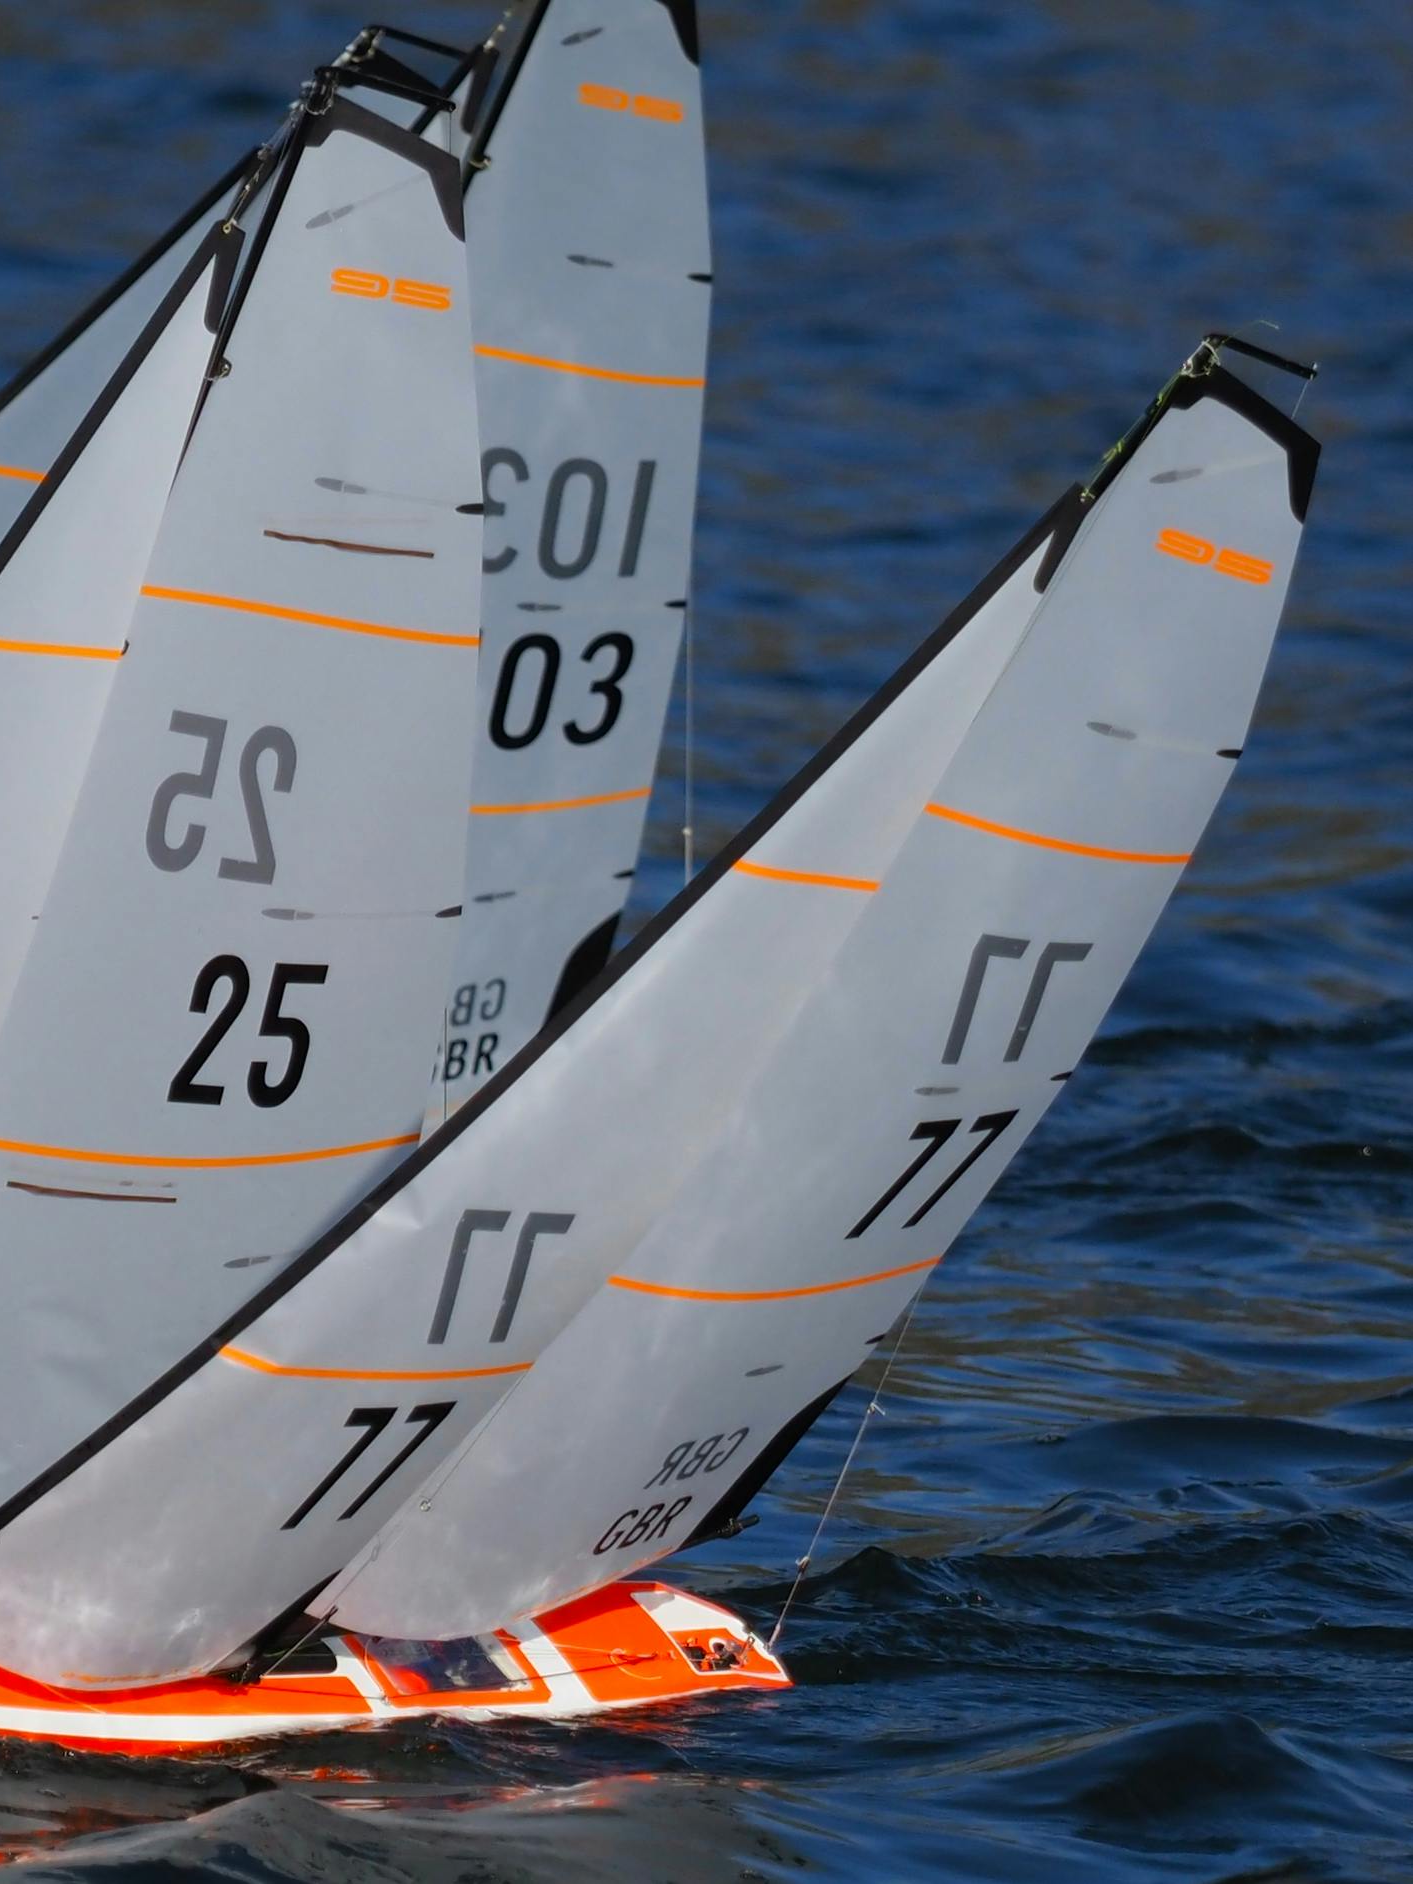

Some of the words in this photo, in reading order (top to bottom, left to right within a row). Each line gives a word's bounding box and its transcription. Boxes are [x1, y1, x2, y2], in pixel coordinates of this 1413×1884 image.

[330, 266, 452, 311] 95
[1155, 526, 1274, 585] 95
[488, 631, 635, 751] 03
[167, 953, 329, 1109] 25
[430, 1032, 498, 1086] BR
[843, 1109, 1020, 1240] 77
[281, 1401, 457, 1531] 77
[592, 1496, 692, 1556] GBR
